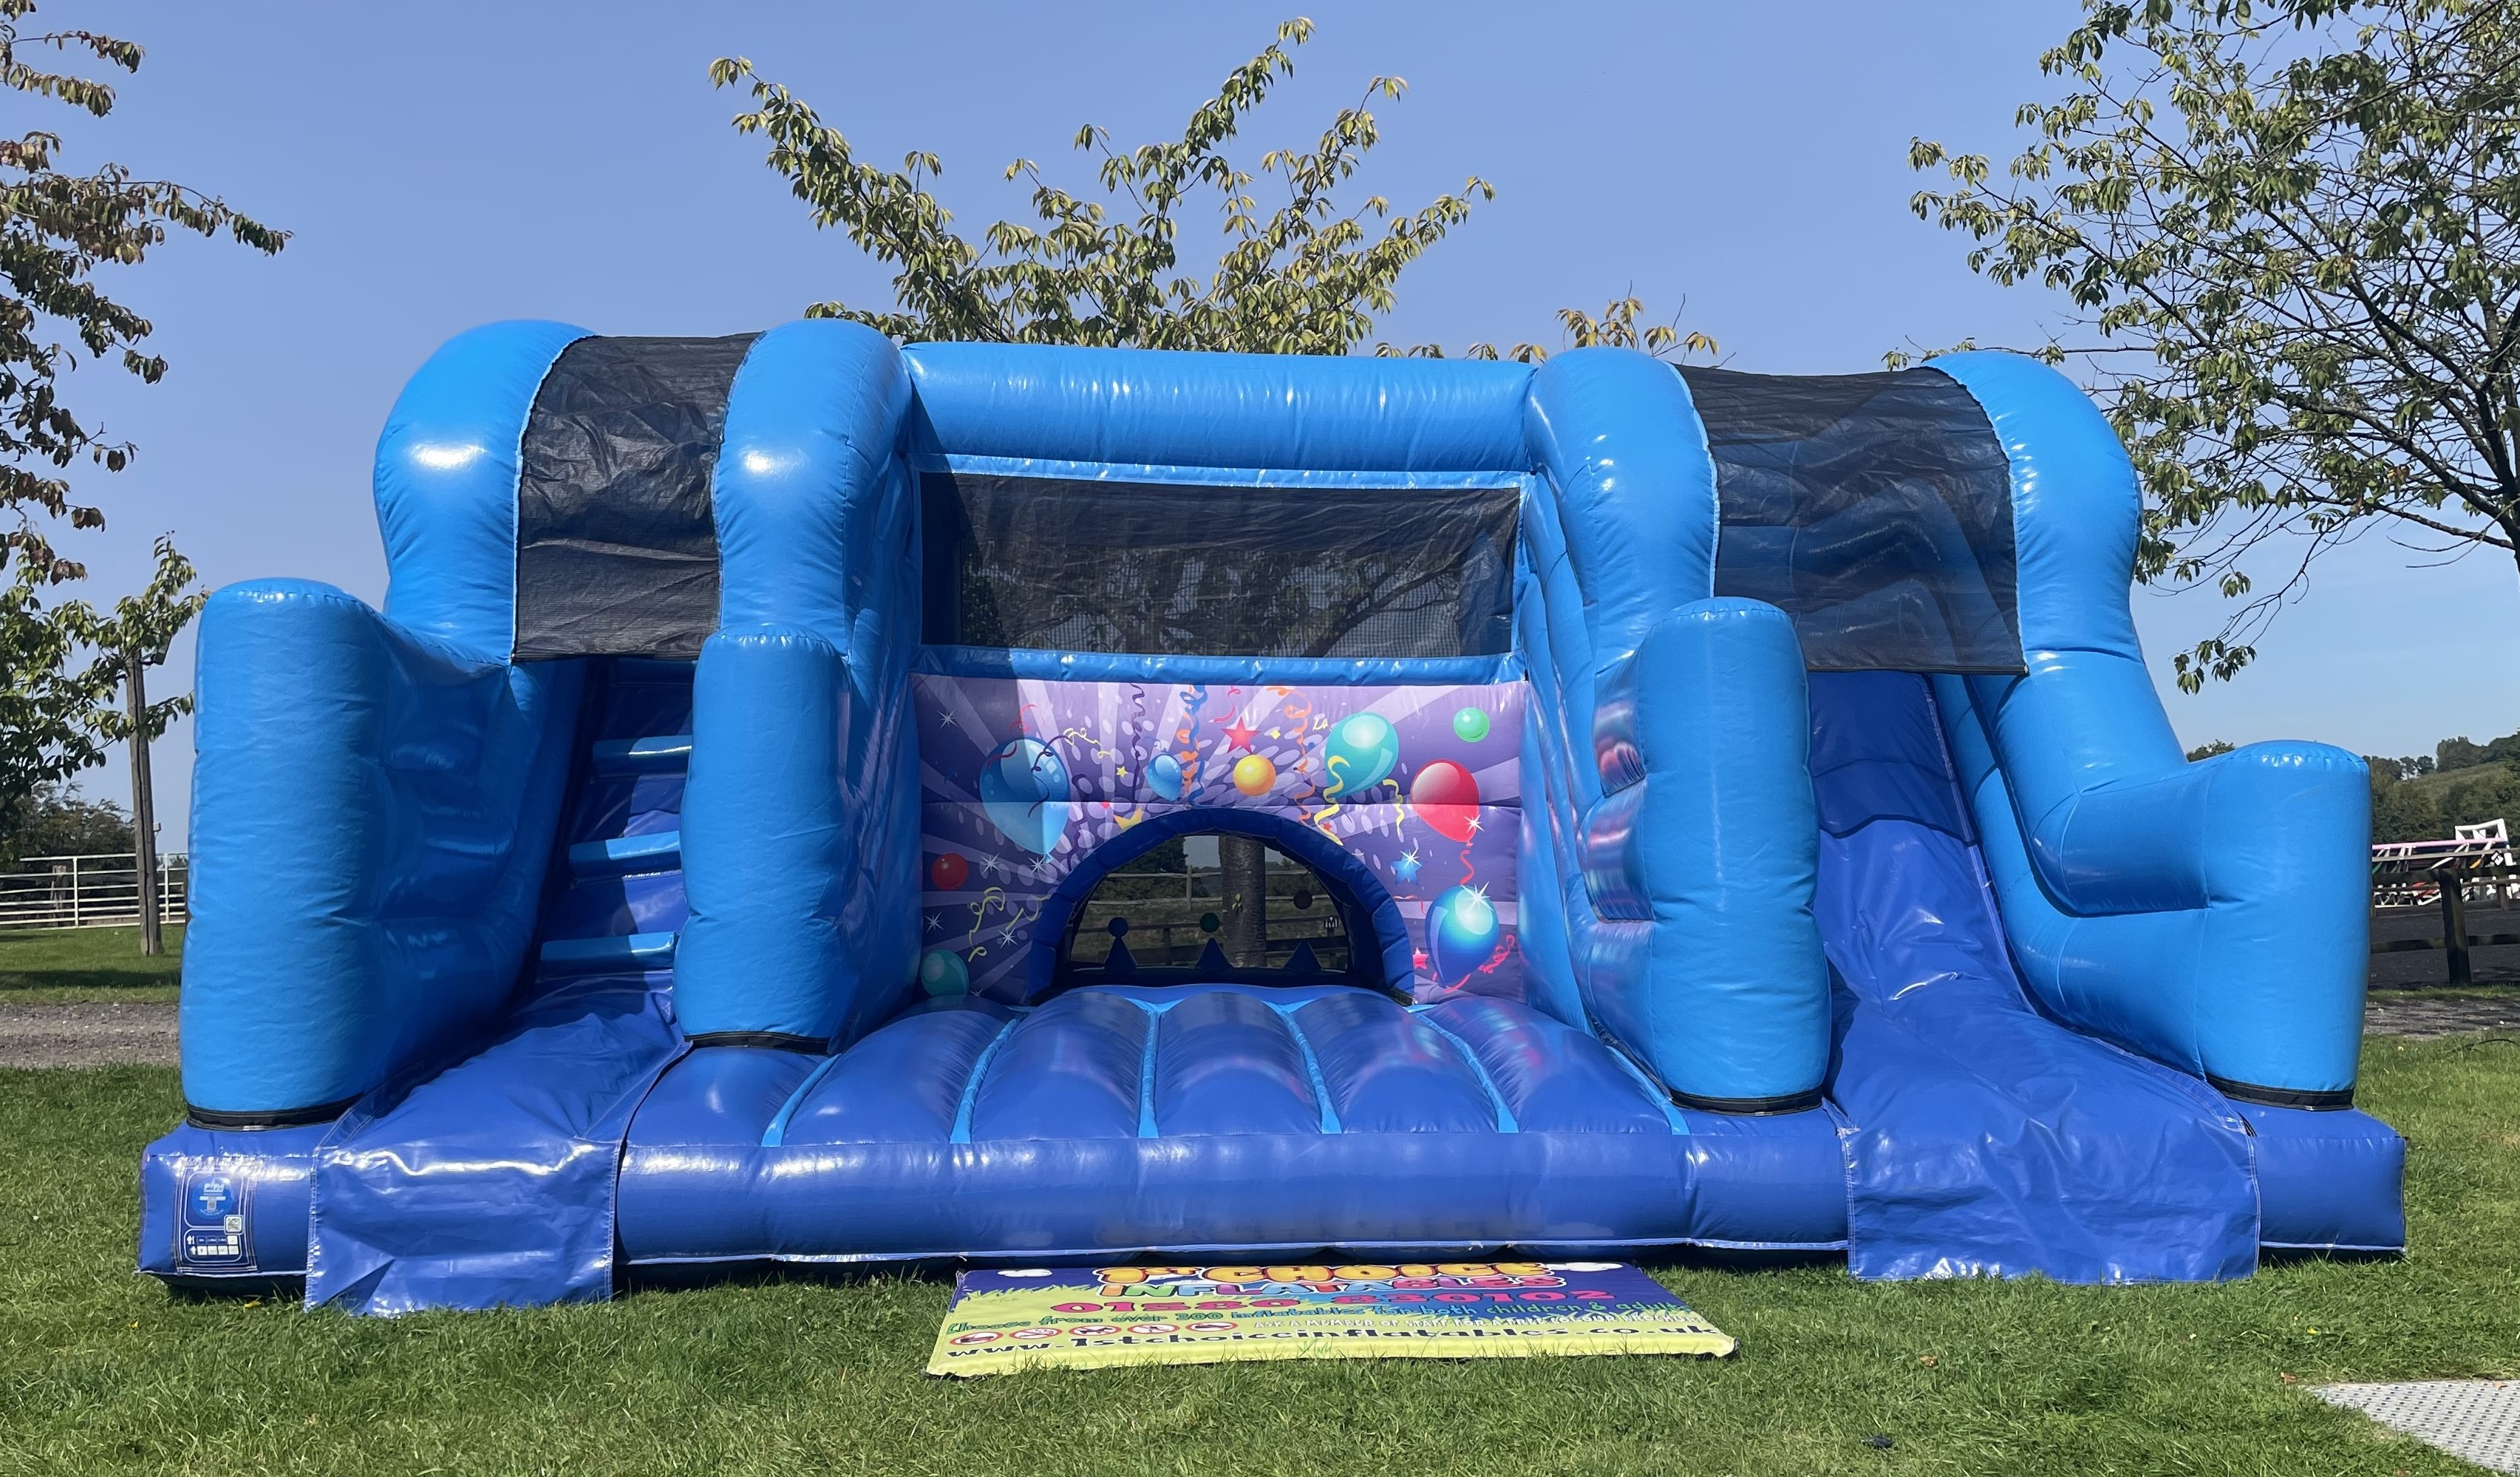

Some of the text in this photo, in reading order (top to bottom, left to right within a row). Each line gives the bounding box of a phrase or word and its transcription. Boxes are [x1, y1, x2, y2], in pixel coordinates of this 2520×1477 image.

[1327, 916, 1337, 928] M
[1202, 1263, 1553, 1283] CHOICE
[1099, 1276, 1567, 1297] INFLATABLES
[1050, 1289, 1616, 1313] 01580 830102
[947, 1322, 1032, 1334] Choose
[1038, 1315, 1103, 1325] from
[1174, 1312, 1224, 1321] 300
[1230, 1307, 1365, 1319] inflatables
[1373, 1305, 1412, 1315] for
[1420, 1305, 1478, 1315] both
[1486, 1303, 1583, 1314] children
[1587, 1301, 1607, 1311] &
[1254, 1320, 1284, 1328] ASK
[1305, 1319, 1375, 1327] MEMBER
[1405, 1319, 1448, 1327] STAFF
[1454, 1319, 1486, 1327] FOR
[1508, 1318, 1547, 1326] FREE
[1550, 1316, 1618, 1324] COLOUR
[947, 1325, 1718, 1357] www.1stchoiceinflatables.co.uk
